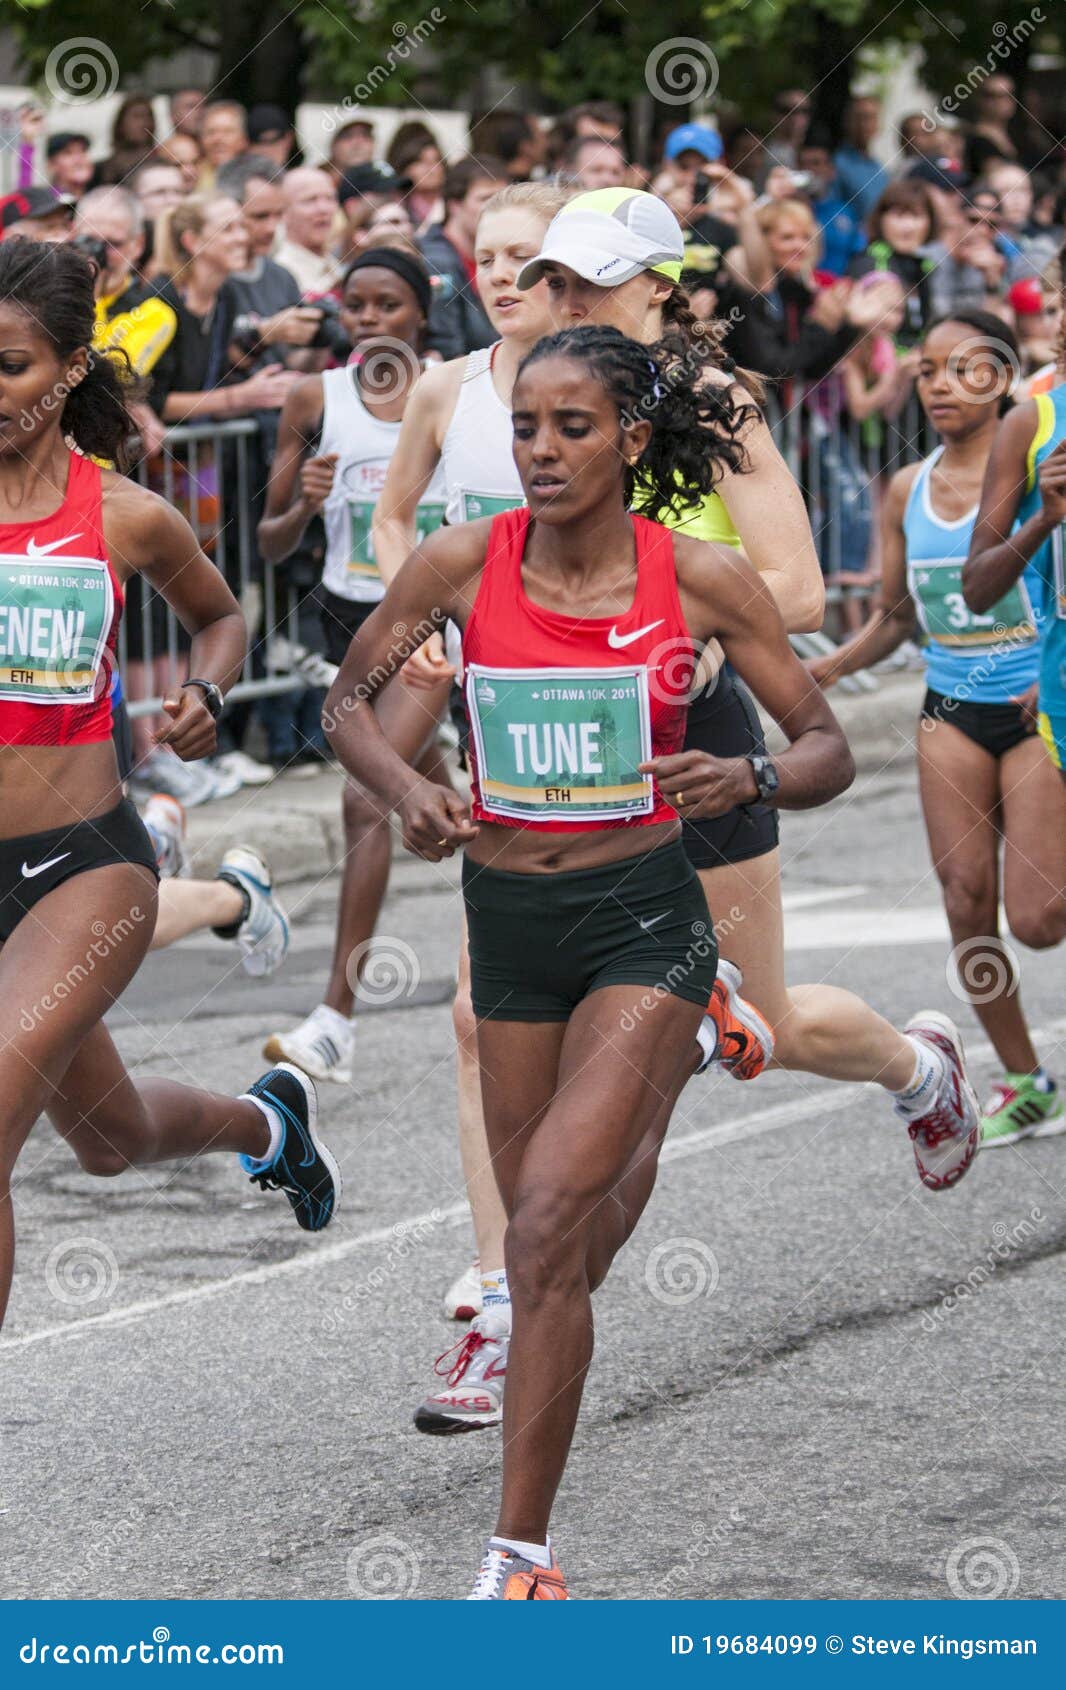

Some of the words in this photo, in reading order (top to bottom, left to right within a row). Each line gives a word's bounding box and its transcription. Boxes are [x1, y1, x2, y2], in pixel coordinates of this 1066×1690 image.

[19, 575, 59, 587] OTTAWA
[62, 576, 79, 589] 10K
[83, 578, 104, 590] 2011
[943, 591, 996, 628] 3
[10, 669, 34, 684] ETH
[543, 688, 585, 701] OTTAWA
[587, 688, 607, 700] 10K
[611, 687, 636, 700] 2011
[507, 721, 603, 776] TUNE
[545, 788, 571, 802] ETH
